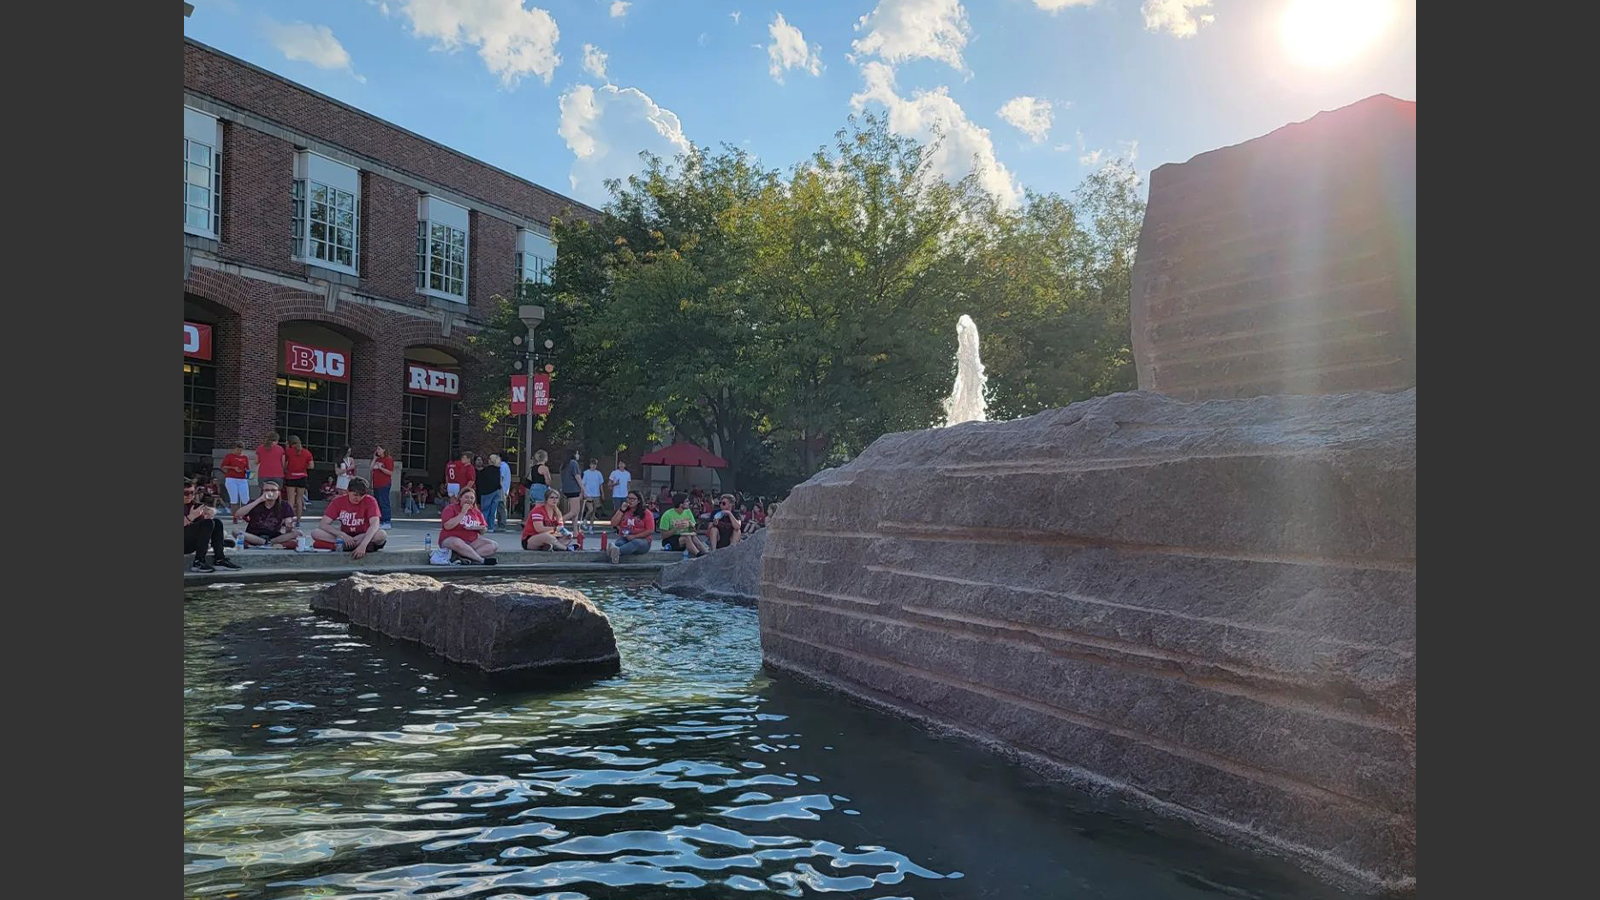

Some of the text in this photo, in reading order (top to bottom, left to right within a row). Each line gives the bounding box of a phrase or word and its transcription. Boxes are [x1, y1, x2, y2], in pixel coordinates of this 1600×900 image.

[409, 366, 459, 395] RED
[534, 382, 543, 390] GO
[512, 386, 526, 403] N
[535, 390, 546, 398] BIG
[535, 398, 548, 406] RED
[449, 468, 455, 480] 8
[342, 517, 365, 526] GLORY
